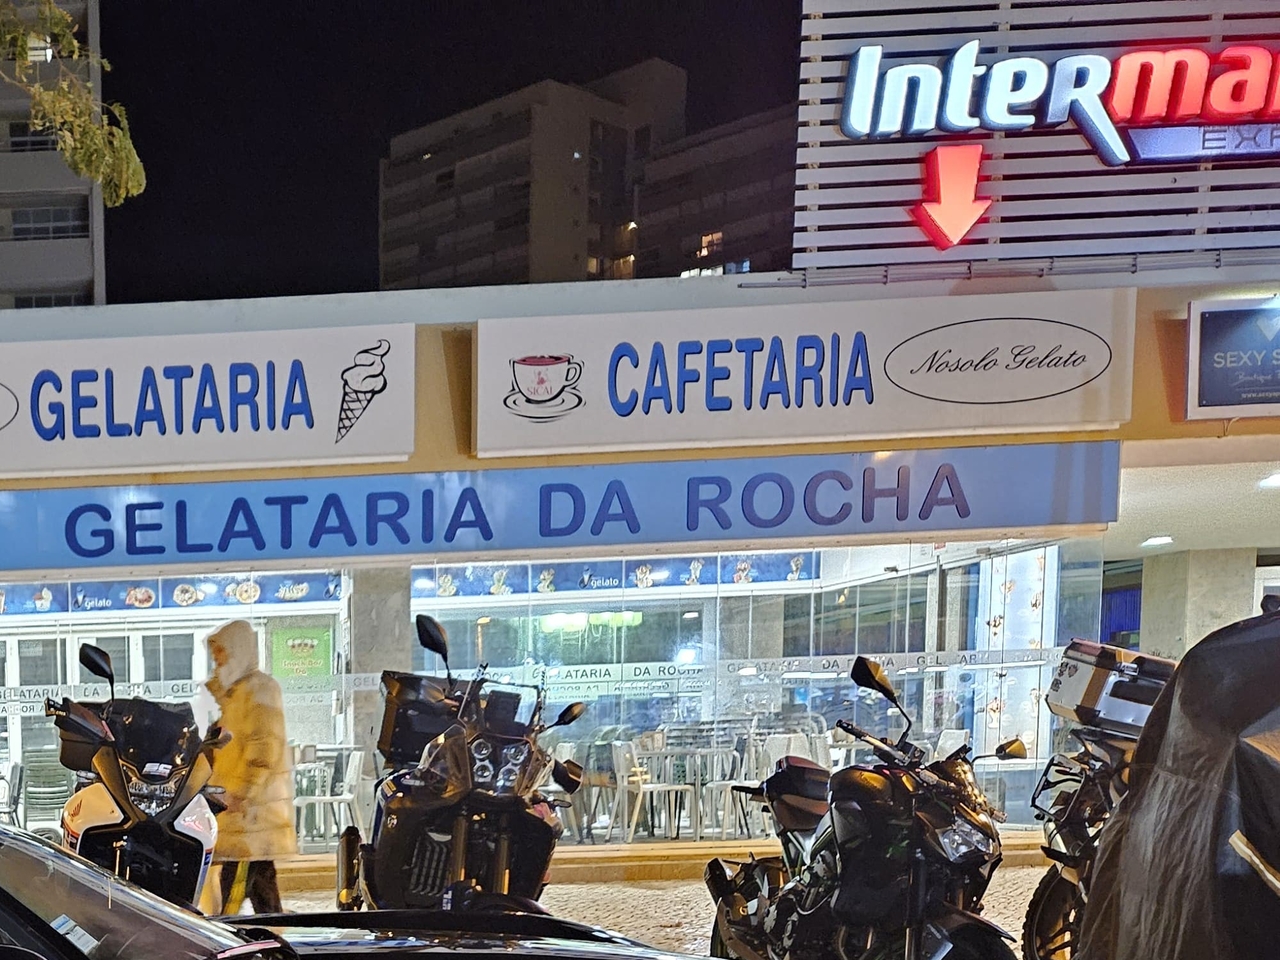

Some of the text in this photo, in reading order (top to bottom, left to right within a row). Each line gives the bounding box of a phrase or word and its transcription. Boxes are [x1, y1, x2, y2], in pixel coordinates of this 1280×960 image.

[909, 342, 1088, 375] Nosolo Gelato
[1213, 349, 1267, 368] SEXY
[608, 330, 875, 417] CAFETARIA
[30, 358, 315, 442] GELATARIA
[65, 463, 972, 558] GELATARIA DA ROCHA
[590, 577, 619, 588] gelato
[353, 676, 378, 688] GEL
[633, 665, 651, 677] DA
